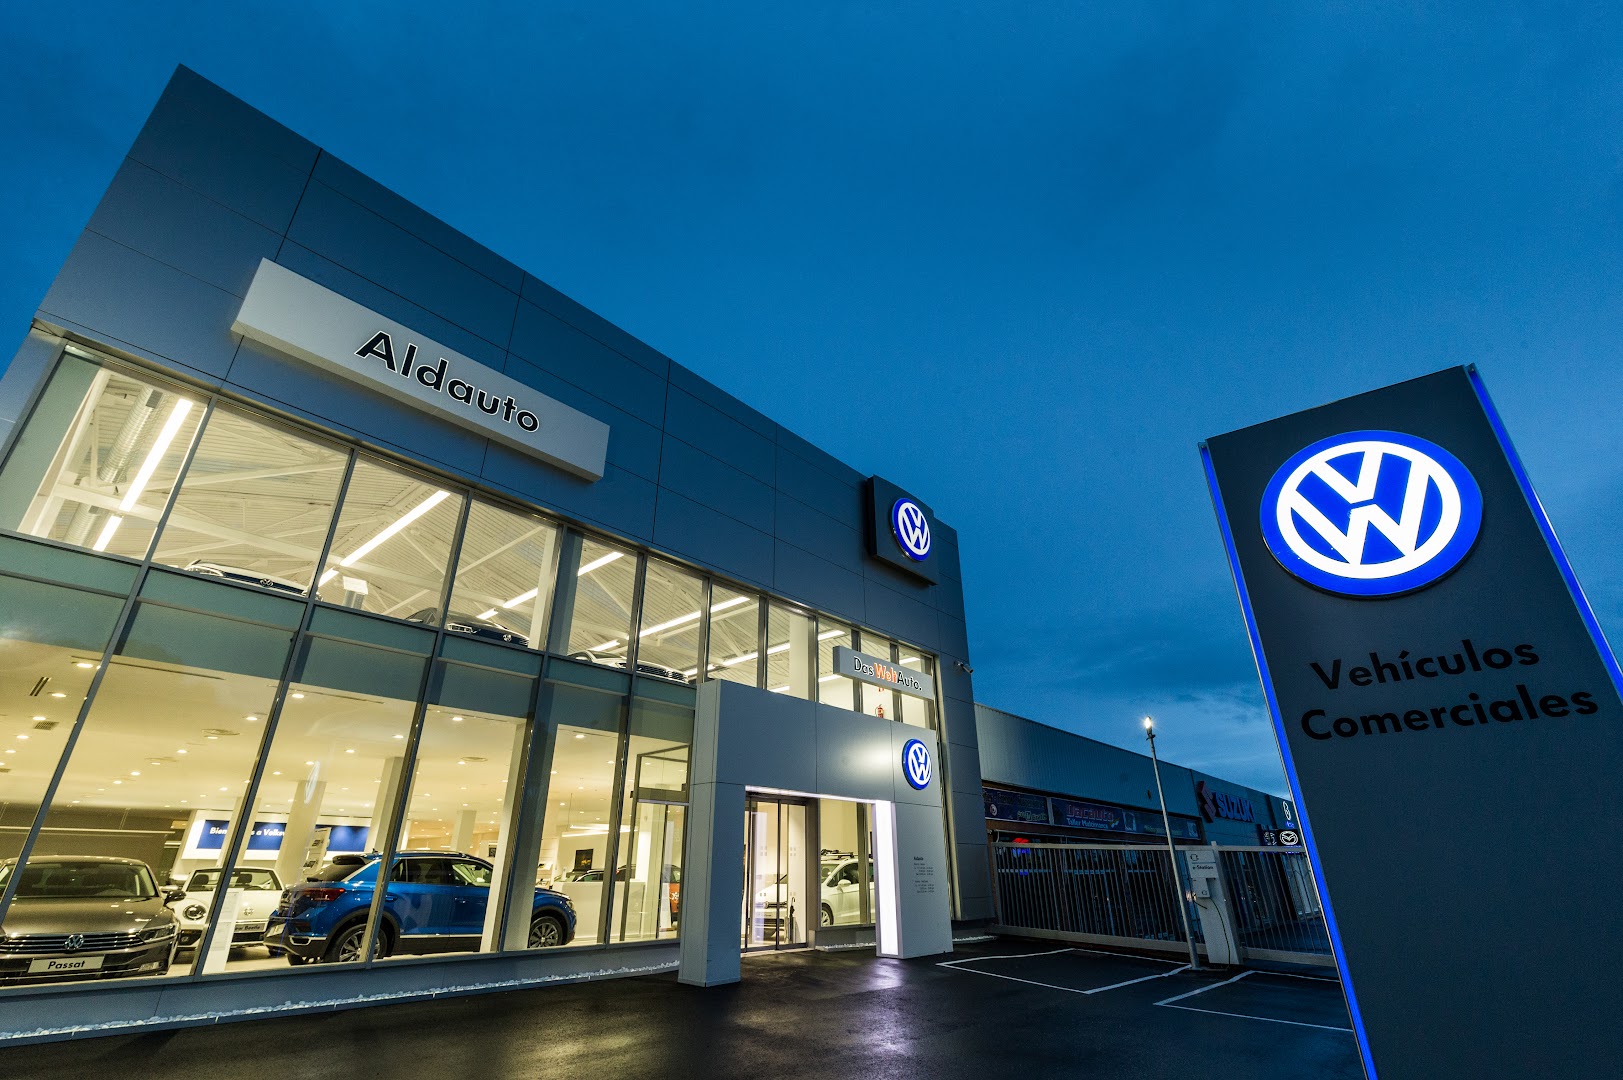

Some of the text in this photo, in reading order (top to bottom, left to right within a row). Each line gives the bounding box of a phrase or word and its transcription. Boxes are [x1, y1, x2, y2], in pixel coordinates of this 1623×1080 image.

[354, 330, 540, 433] Aldauto
[1309, 638, 1540, 691] Vehículos
[1300, 684, 1599, 741] Comerciales
[1216, 792, 1256, 823] SUZUKI
[263, 828, 285, 836] Volks
[47, 960, 86, 970] Passat
